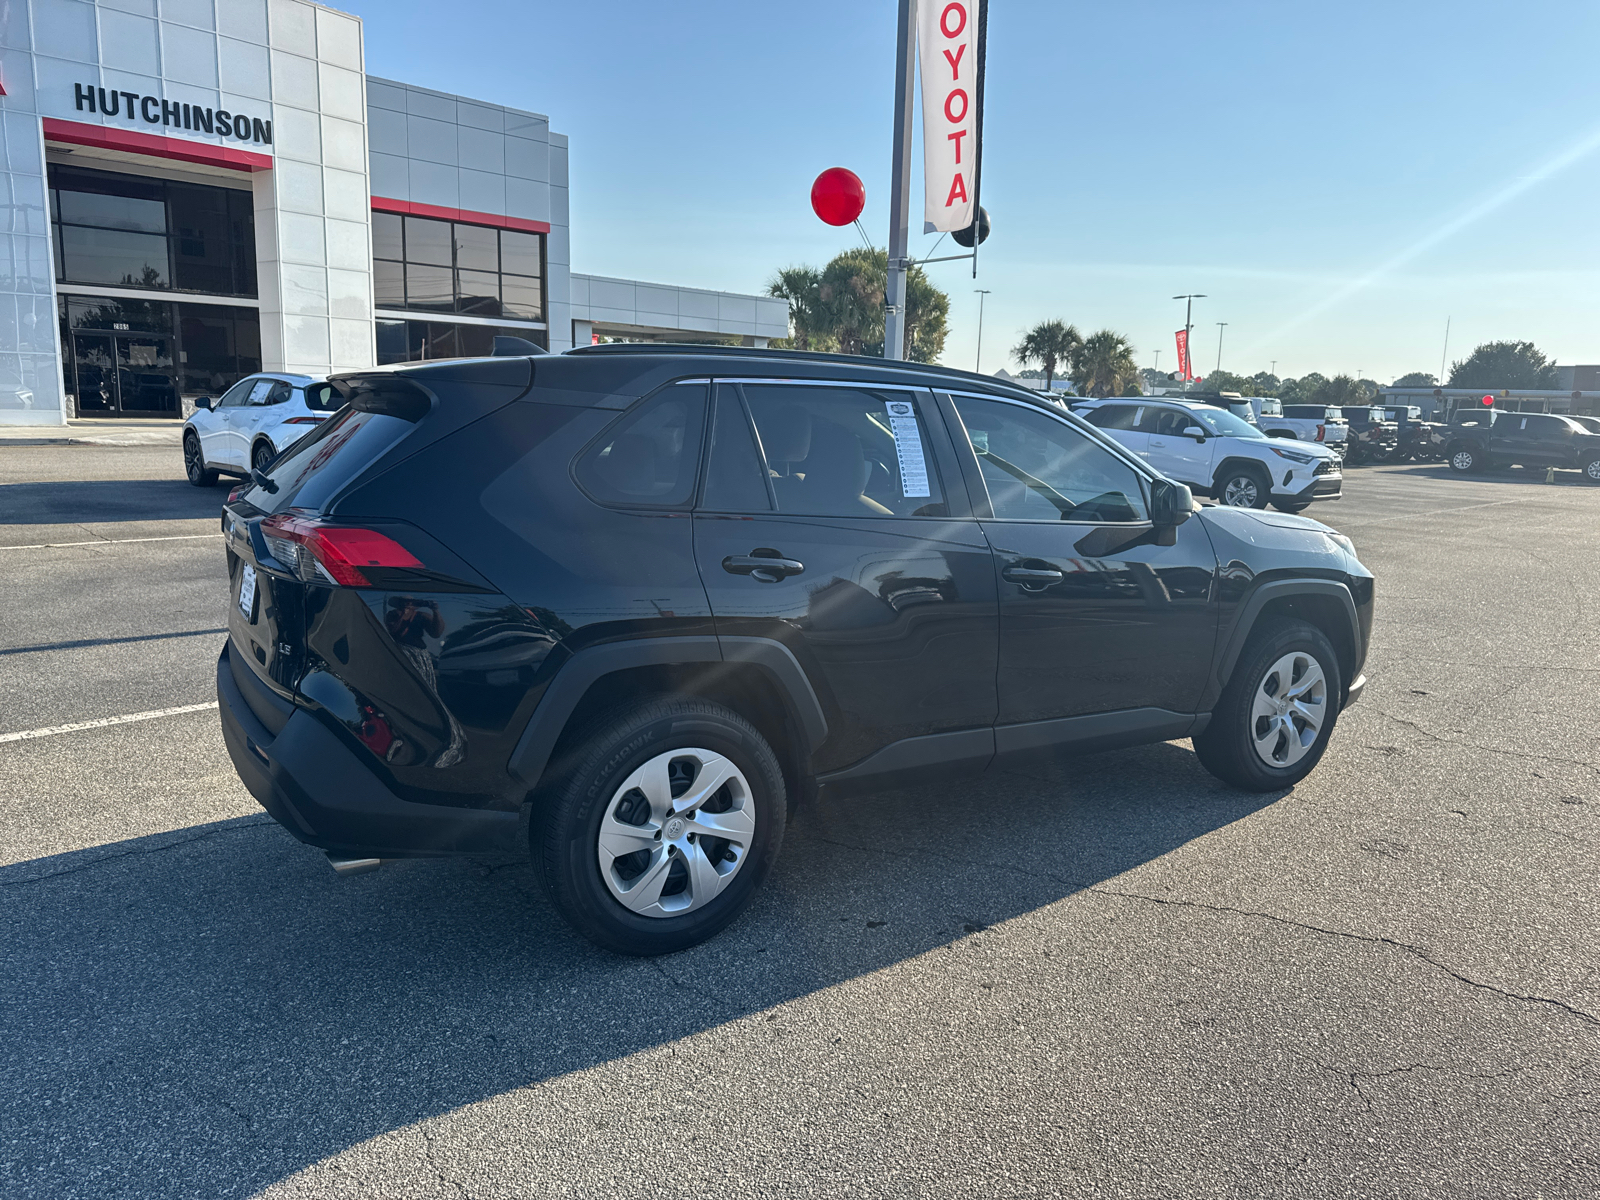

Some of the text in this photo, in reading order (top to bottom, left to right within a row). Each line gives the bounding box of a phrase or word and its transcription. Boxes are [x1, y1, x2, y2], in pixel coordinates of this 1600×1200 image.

[74, 82, 273, 145] HUTCHINSON
[939, 1, 968, 208] OYOTA
[278, 642, 292, 656] LE
[576, 730, 656, 822] BLACKHAWK
